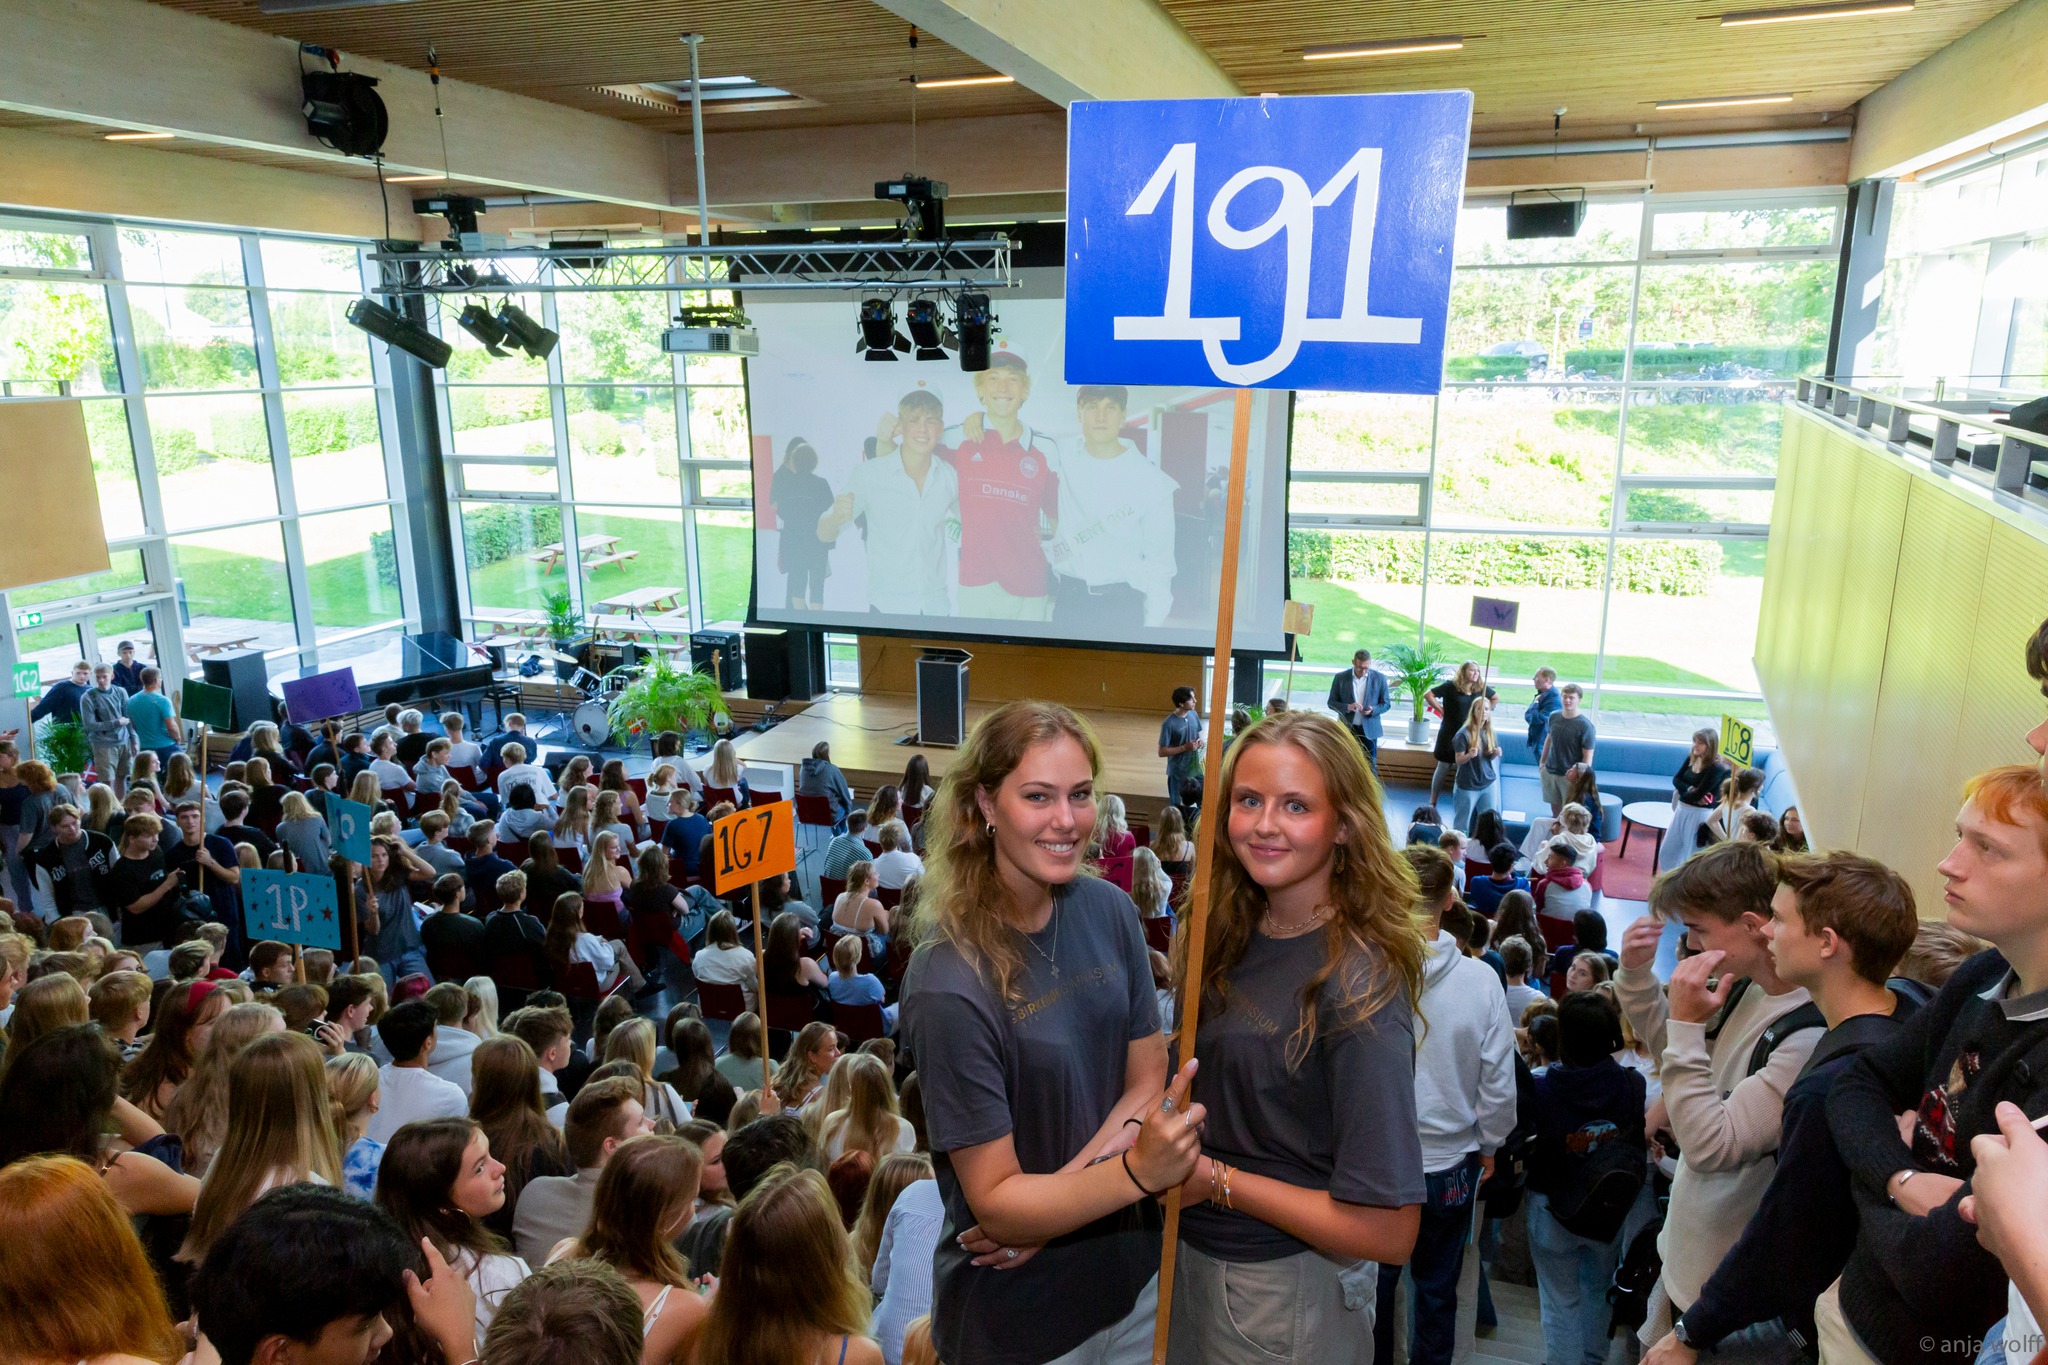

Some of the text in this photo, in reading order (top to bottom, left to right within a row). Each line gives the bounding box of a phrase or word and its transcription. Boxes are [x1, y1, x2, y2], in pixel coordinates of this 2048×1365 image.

[982, 483, 1028, 502] Danske
[13, 669, 40, 694] 1G2
[1724, 717, 1751, 762] 1G8
[719, 810, 773, 876] 1G7
[265, 883, 308, 932] 1P
